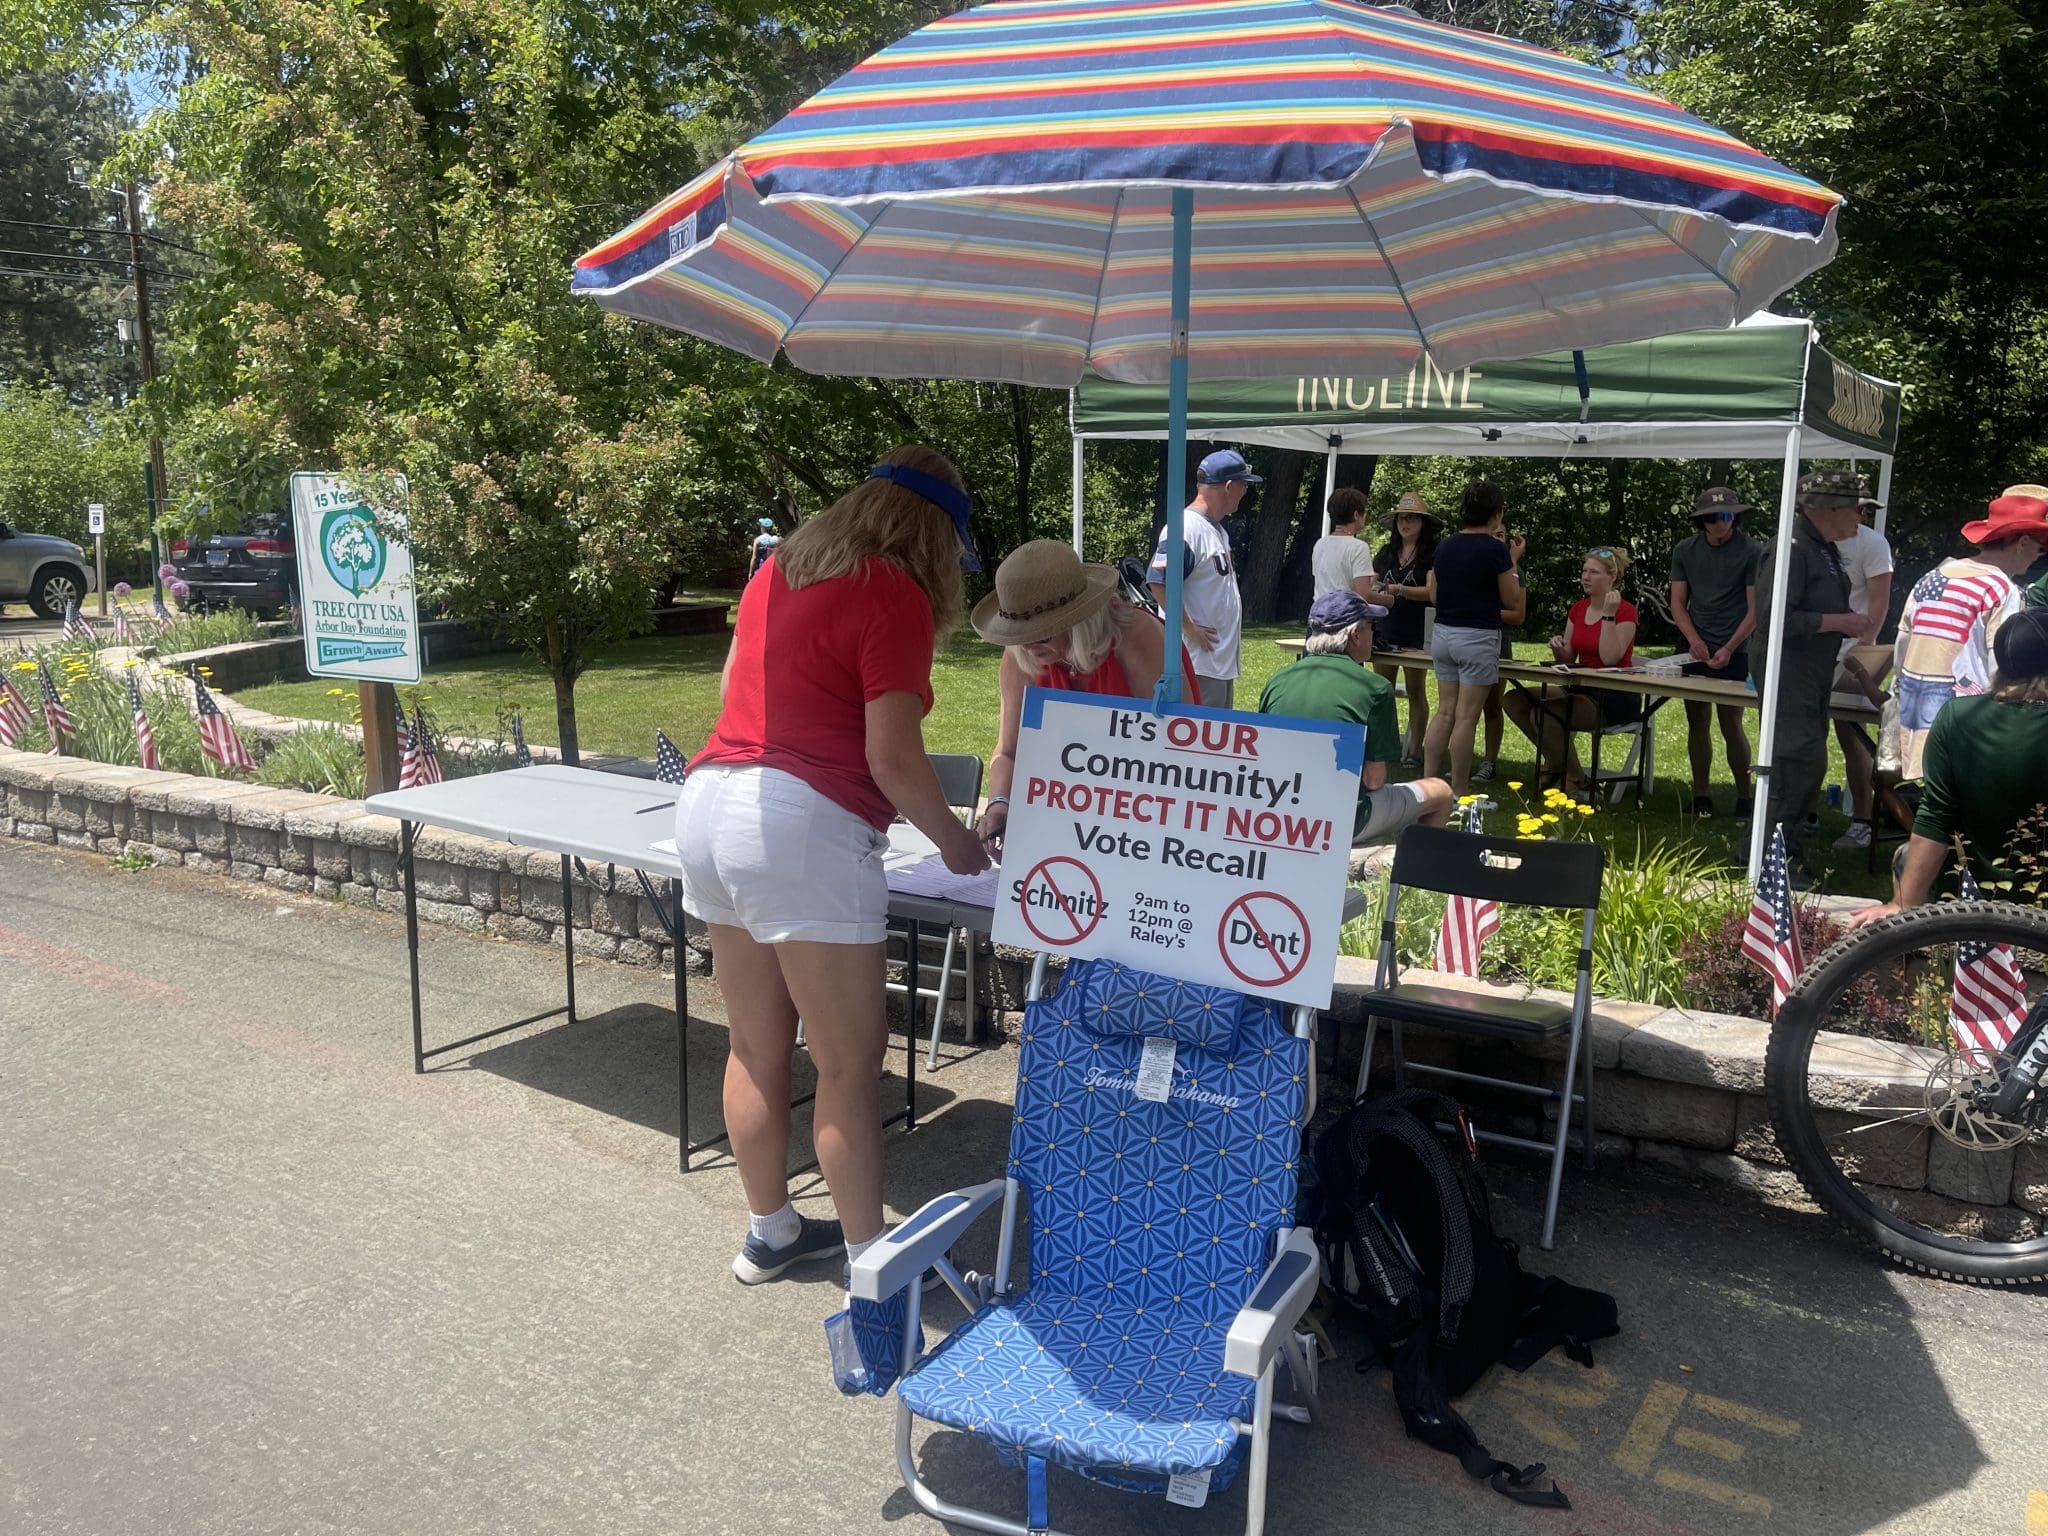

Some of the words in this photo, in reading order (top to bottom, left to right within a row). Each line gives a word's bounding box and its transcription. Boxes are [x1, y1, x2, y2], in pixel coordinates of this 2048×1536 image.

[315, 493, 328, 508] 15
[313, 600, 346, 618] TREE
[347, 602, 377, 620] CITY
[380, 604, 406, 622] USA
[315, 619, 339, 632] Arbor
[340, 621, 357, 637] Day
[359, 623, 407, 637] Foundation
[322, 645, 362, 656] Growth
[364, 646, 398, 656] Award
[1109, 710, 1157, 741] It's
[1166, 717, 1260, 757] OUR
[1060, 742, 1302, 808] Community!
[1026, 776, 1176, 826] PROTECT
[1184, 801, 1217, 832] IT
[1226, 806, 1333, 852] NOW!
[1074, 822, 1151, 861] Vote
[1161, 836, 1267, 880] Recall
[1010, 879, 1109, 919] Schmitz
[1134, 892, 1170, 911] 9am
[1173, 900, 1190, 914] to
[1128, 908, 1173, 930] 12pm
[1177, 918, 1193, 934] @
[1130, 925, 1186, 949] Raley's
[1230, 918, 1300, 956] Dent
[1083, 1066, 1143, 1101] Tomm
